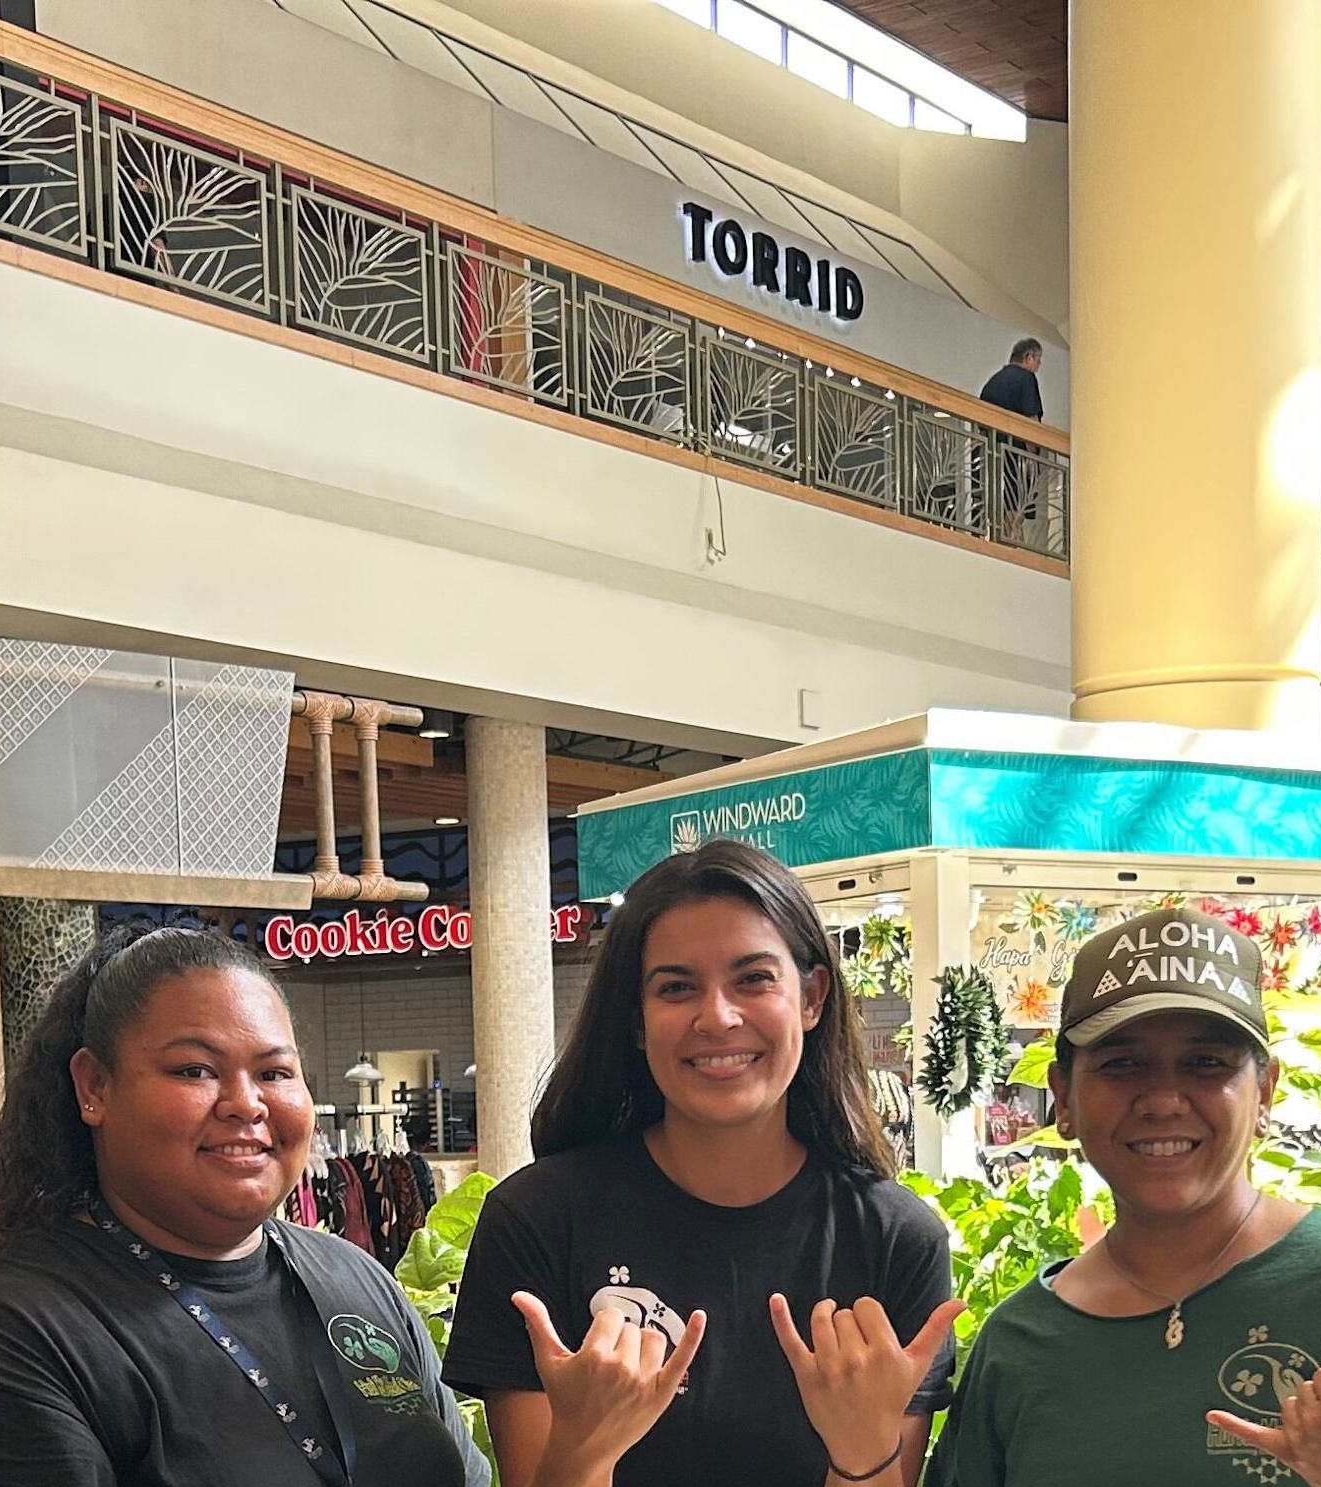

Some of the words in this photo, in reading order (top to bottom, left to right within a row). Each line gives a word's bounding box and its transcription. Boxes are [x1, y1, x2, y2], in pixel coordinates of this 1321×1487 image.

[683, 202, 864, 320] TORRID
[703, 793, 806, 834] WINDWARD
[265, 909, 414, 960] Cookie
[980, 936, 1034, 973] Hapa
[1107, 921, 1238, 966] ALOHA
